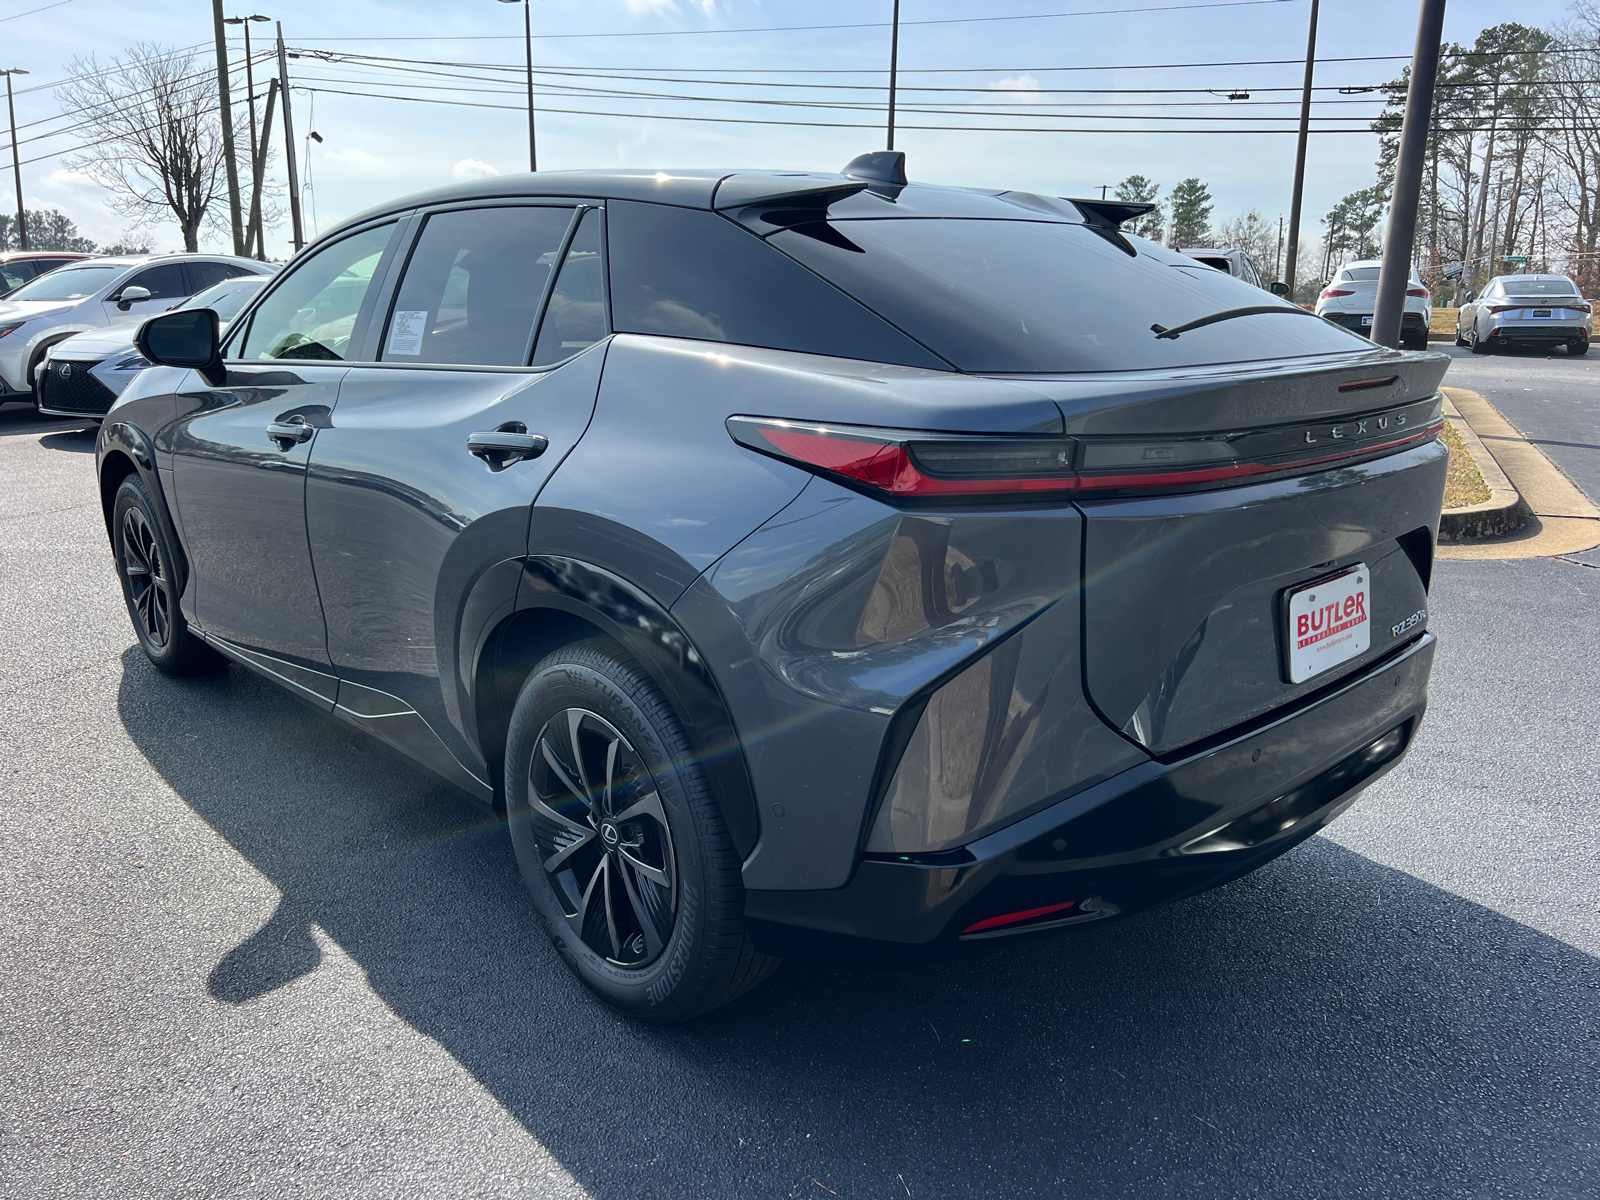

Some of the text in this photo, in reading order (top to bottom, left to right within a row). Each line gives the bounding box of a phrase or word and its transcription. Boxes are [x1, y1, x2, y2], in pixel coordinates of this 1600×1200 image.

[1304, 413, 1406, 444] LEXUS
[592, 677, 664, 765] TURANZA
[646, 878, 699, 1007] BRIDGESTONE
